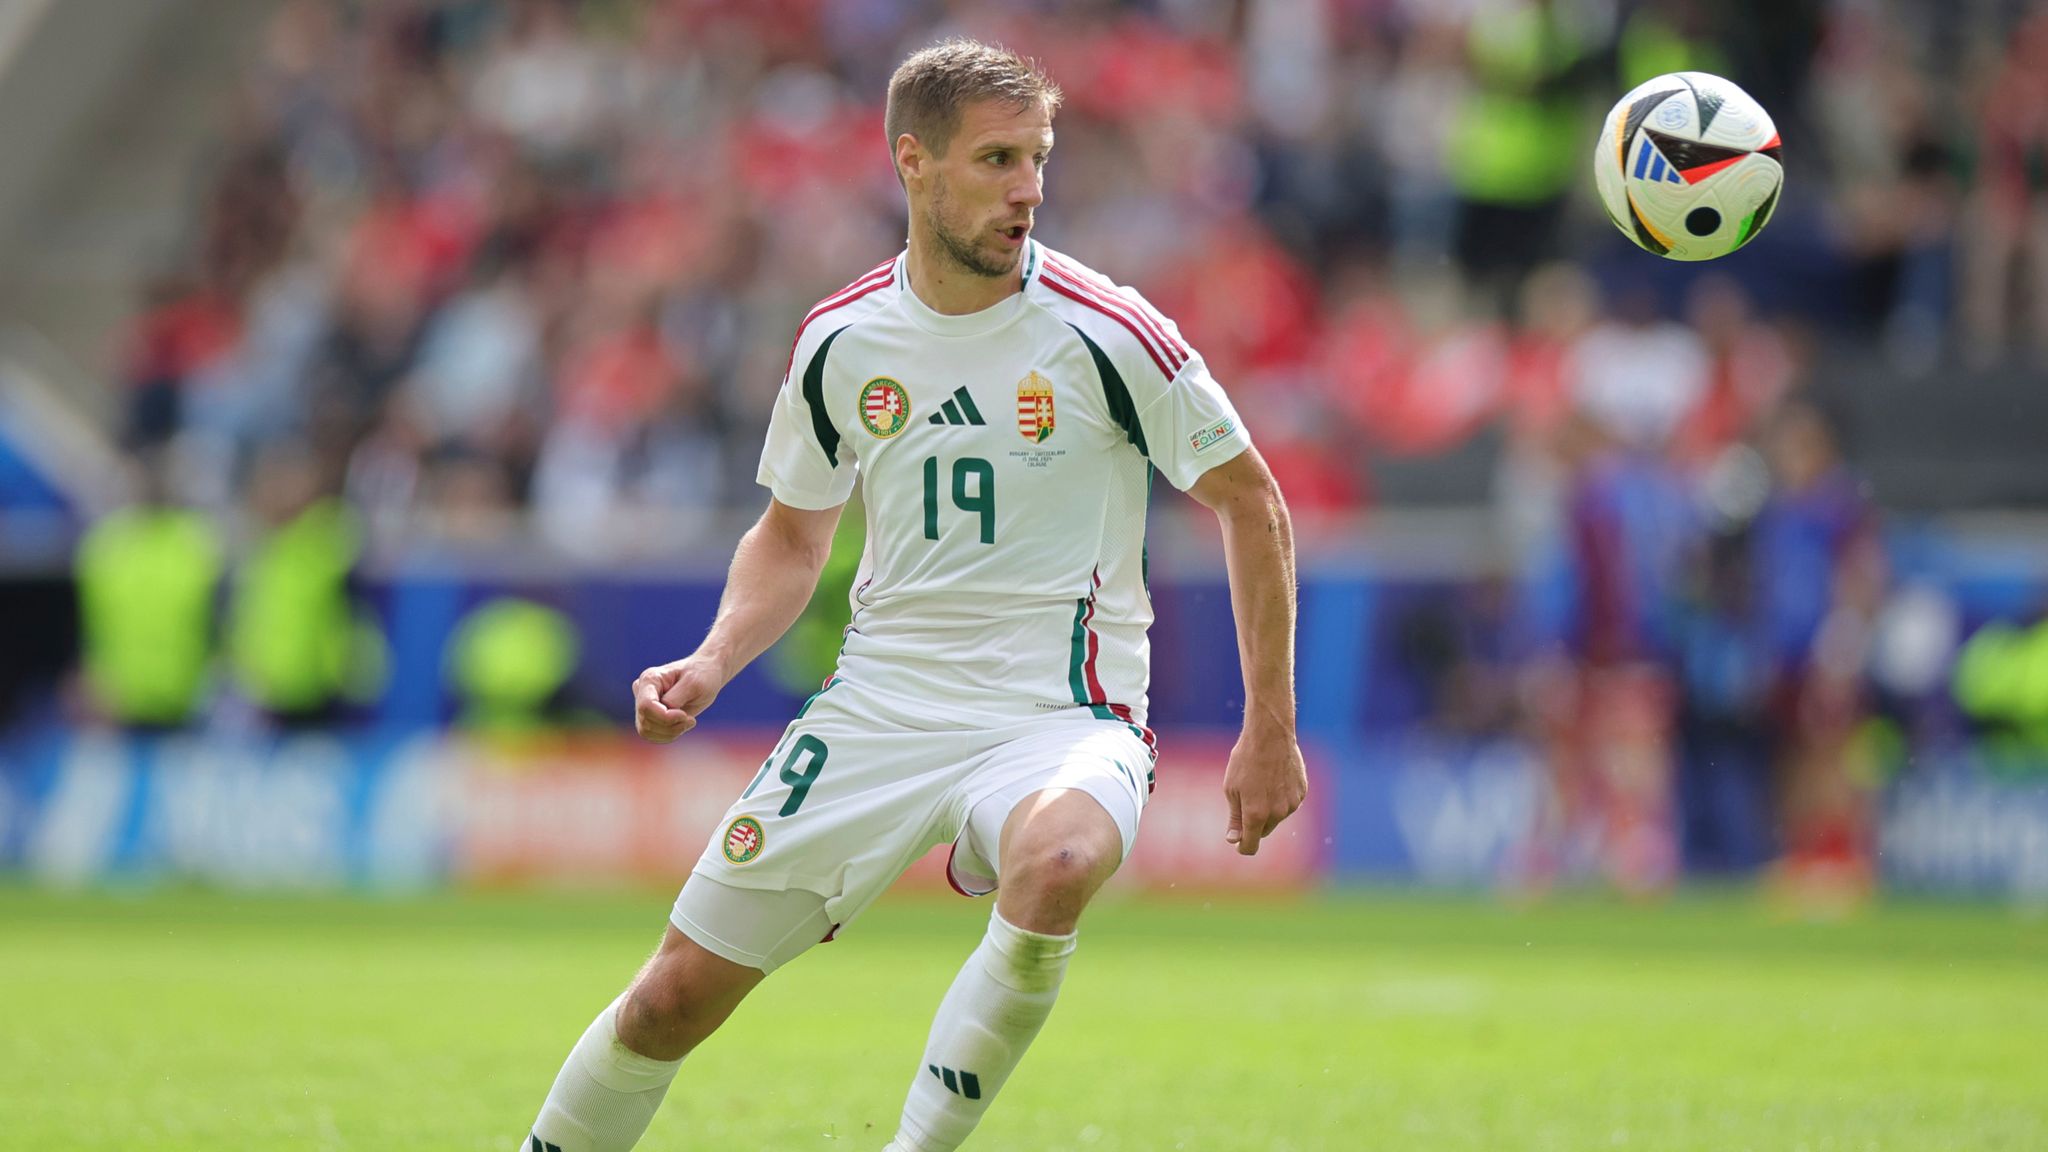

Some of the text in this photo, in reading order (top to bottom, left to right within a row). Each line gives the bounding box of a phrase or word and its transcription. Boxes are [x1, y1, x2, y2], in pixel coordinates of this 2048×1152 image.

[1190, 429, 1206, 442] UEFA
[1192, 422, 1231, 449] FOUND
[923, 456, 995, 545] 19
